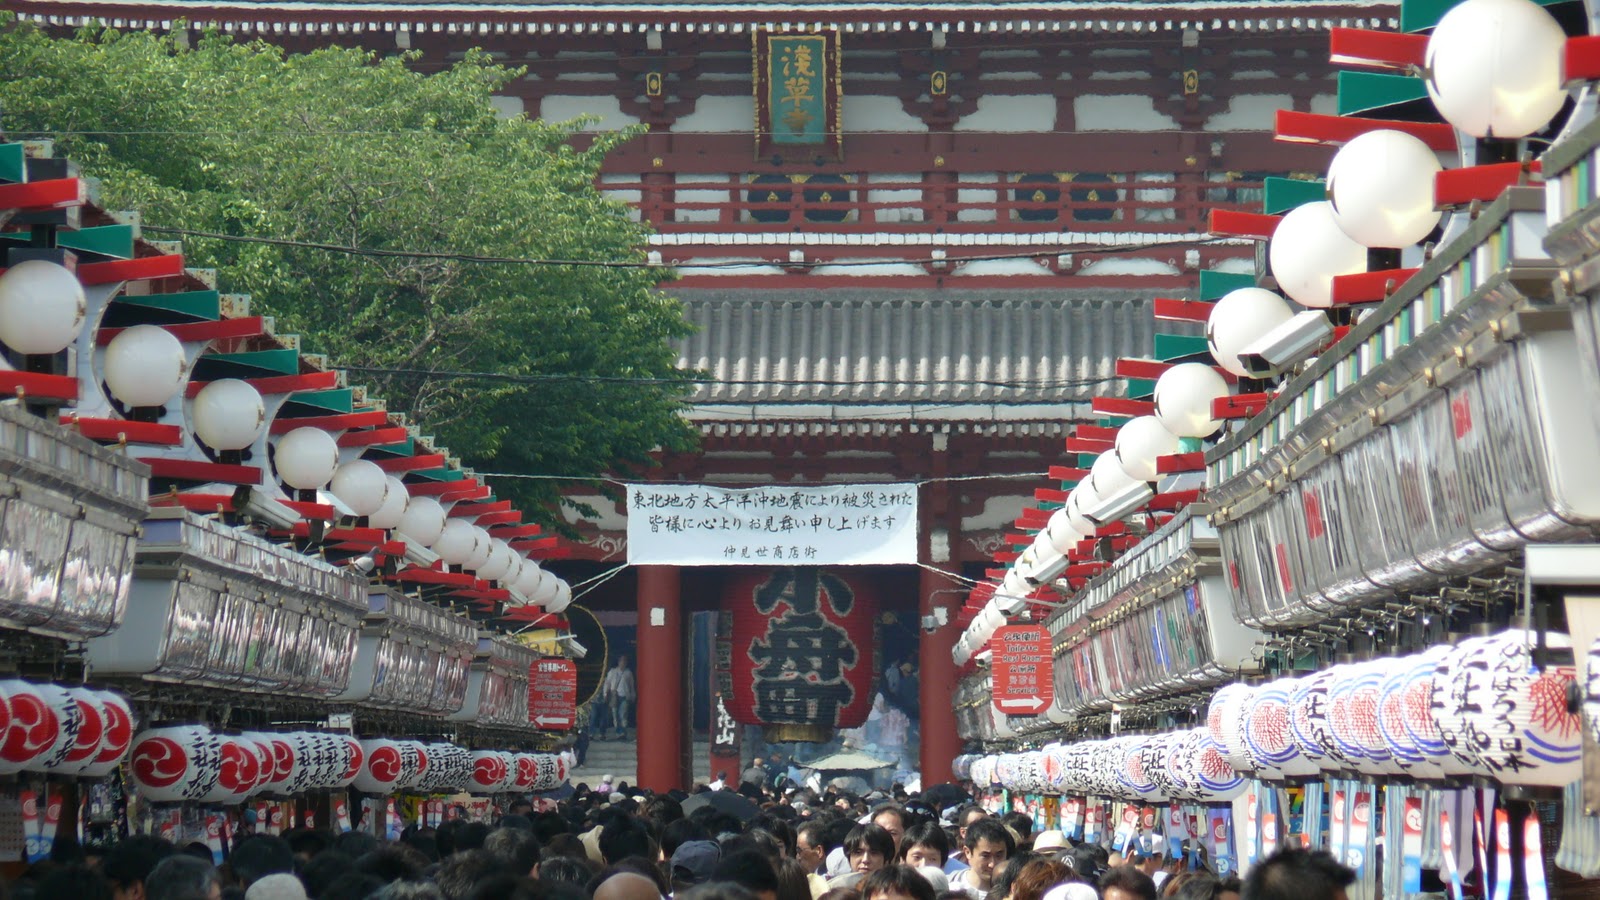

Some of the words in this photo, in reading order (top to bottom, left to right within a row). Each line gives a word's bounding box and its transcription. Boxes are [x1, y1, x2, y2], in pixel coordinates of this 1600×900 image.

[632, 490, 913, 510] 東北地方太平洋沖地震により被災された
[648, 514, 896, 533] 皆様に心よりお見舞い申し上げます
[723, 545, 818, 560] 仲見世商店街
[747, 565, 859, 727] 小舟町
[1005, 644, 1038, 653] Toilette
[1003, 655, 1019, 663] Rest
[1021, 655, 1041, 663] Room
